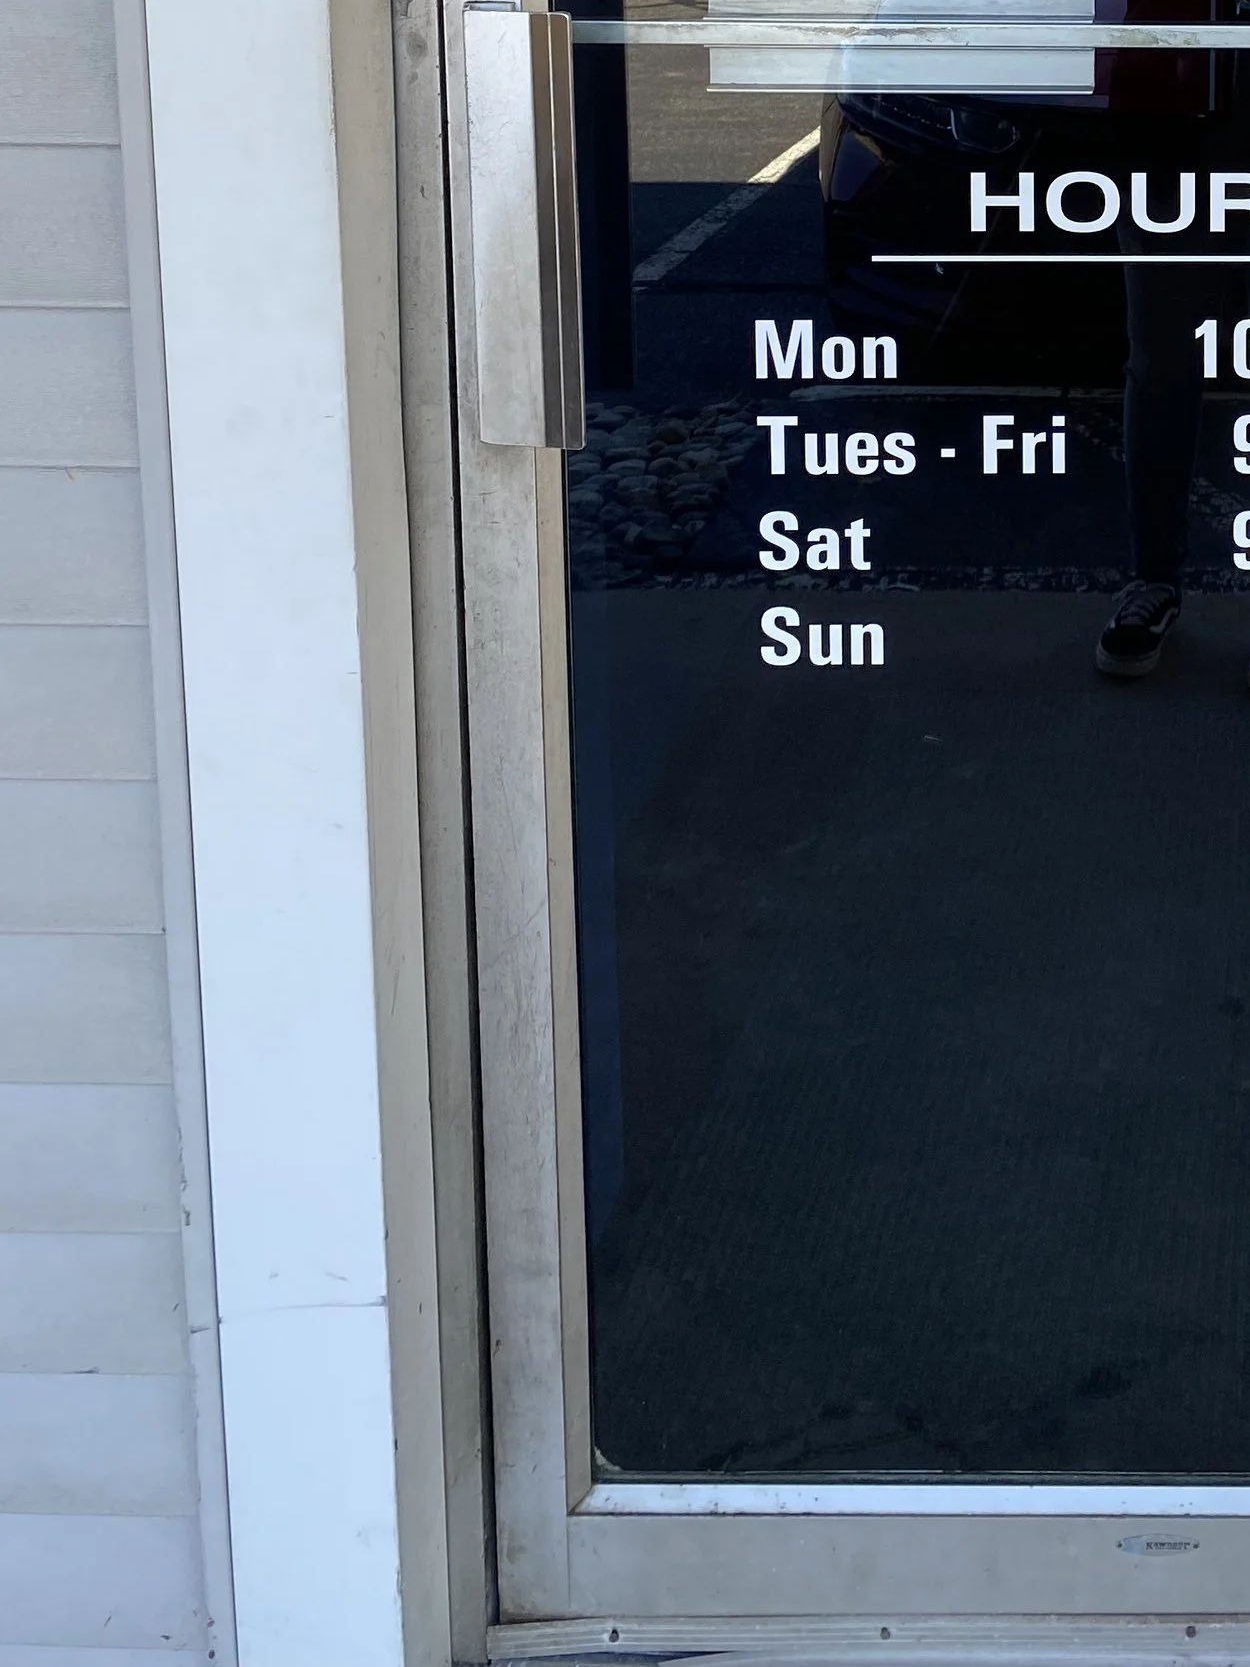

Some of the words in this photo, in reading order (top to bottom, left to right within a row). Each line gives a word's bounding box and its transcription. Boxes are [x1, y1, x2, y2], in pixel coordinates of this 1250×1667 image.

[754, 319, 898, 380] Mon
[756, 415, 917, 476] Tues
[982, 415, 1067, 475] Fri
[758, 510, 871, 571] Sat
[760, 606, 885, 666] Sun
